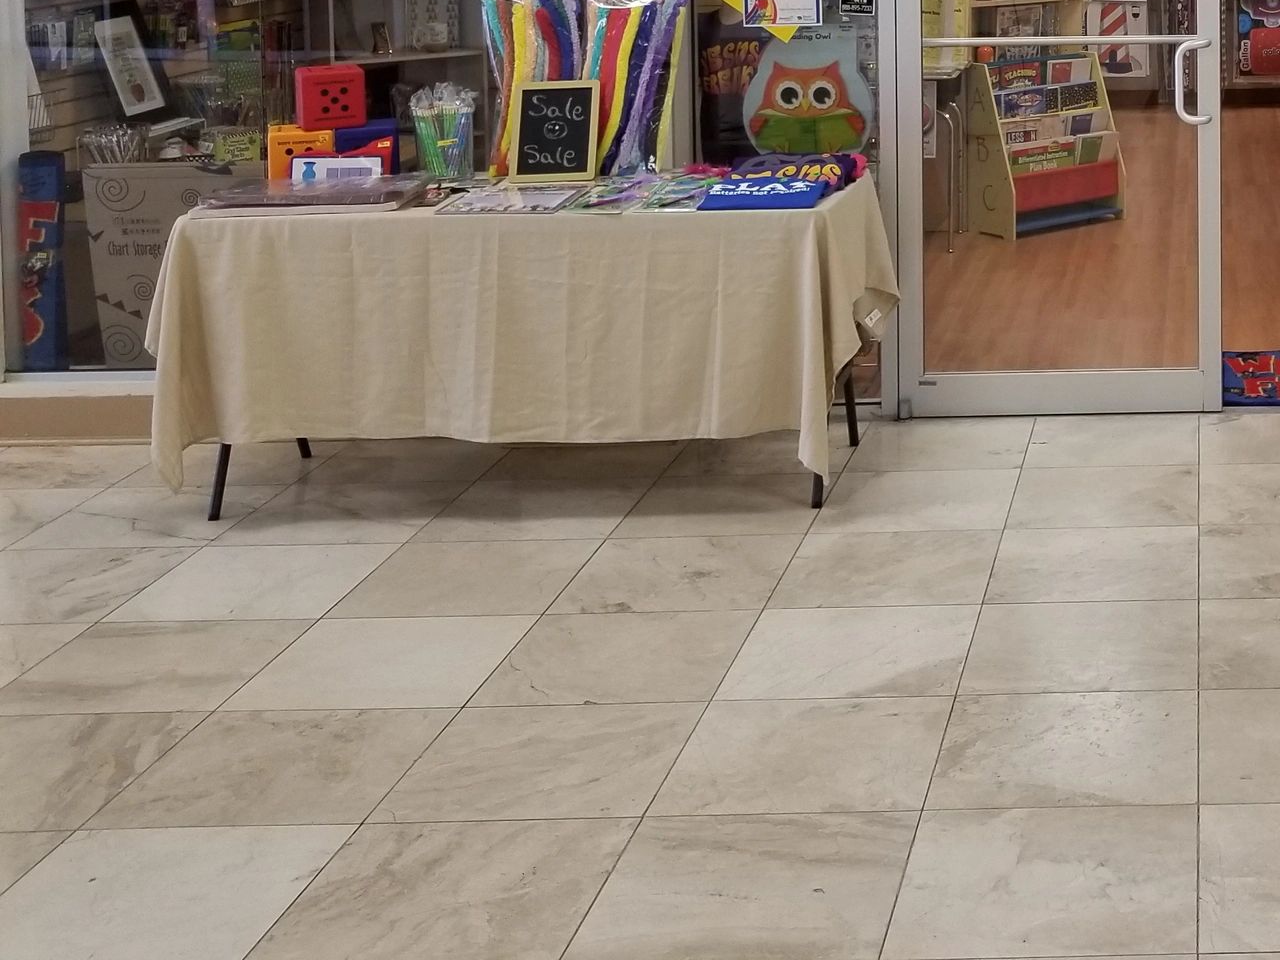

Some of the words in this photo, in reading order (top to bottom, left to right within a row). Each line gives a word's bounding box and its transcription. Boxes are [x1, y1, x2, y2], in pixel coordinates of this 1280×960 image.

[792, 33, 813, 41] ading
[1241, 41, 1249, 69] Gallon
[528, 95, 584, 121] Sale
[524, 144, 577, 167] Sale
[108, 240, 130, 256] Chart
[134, 240, 162, 259] Storage
